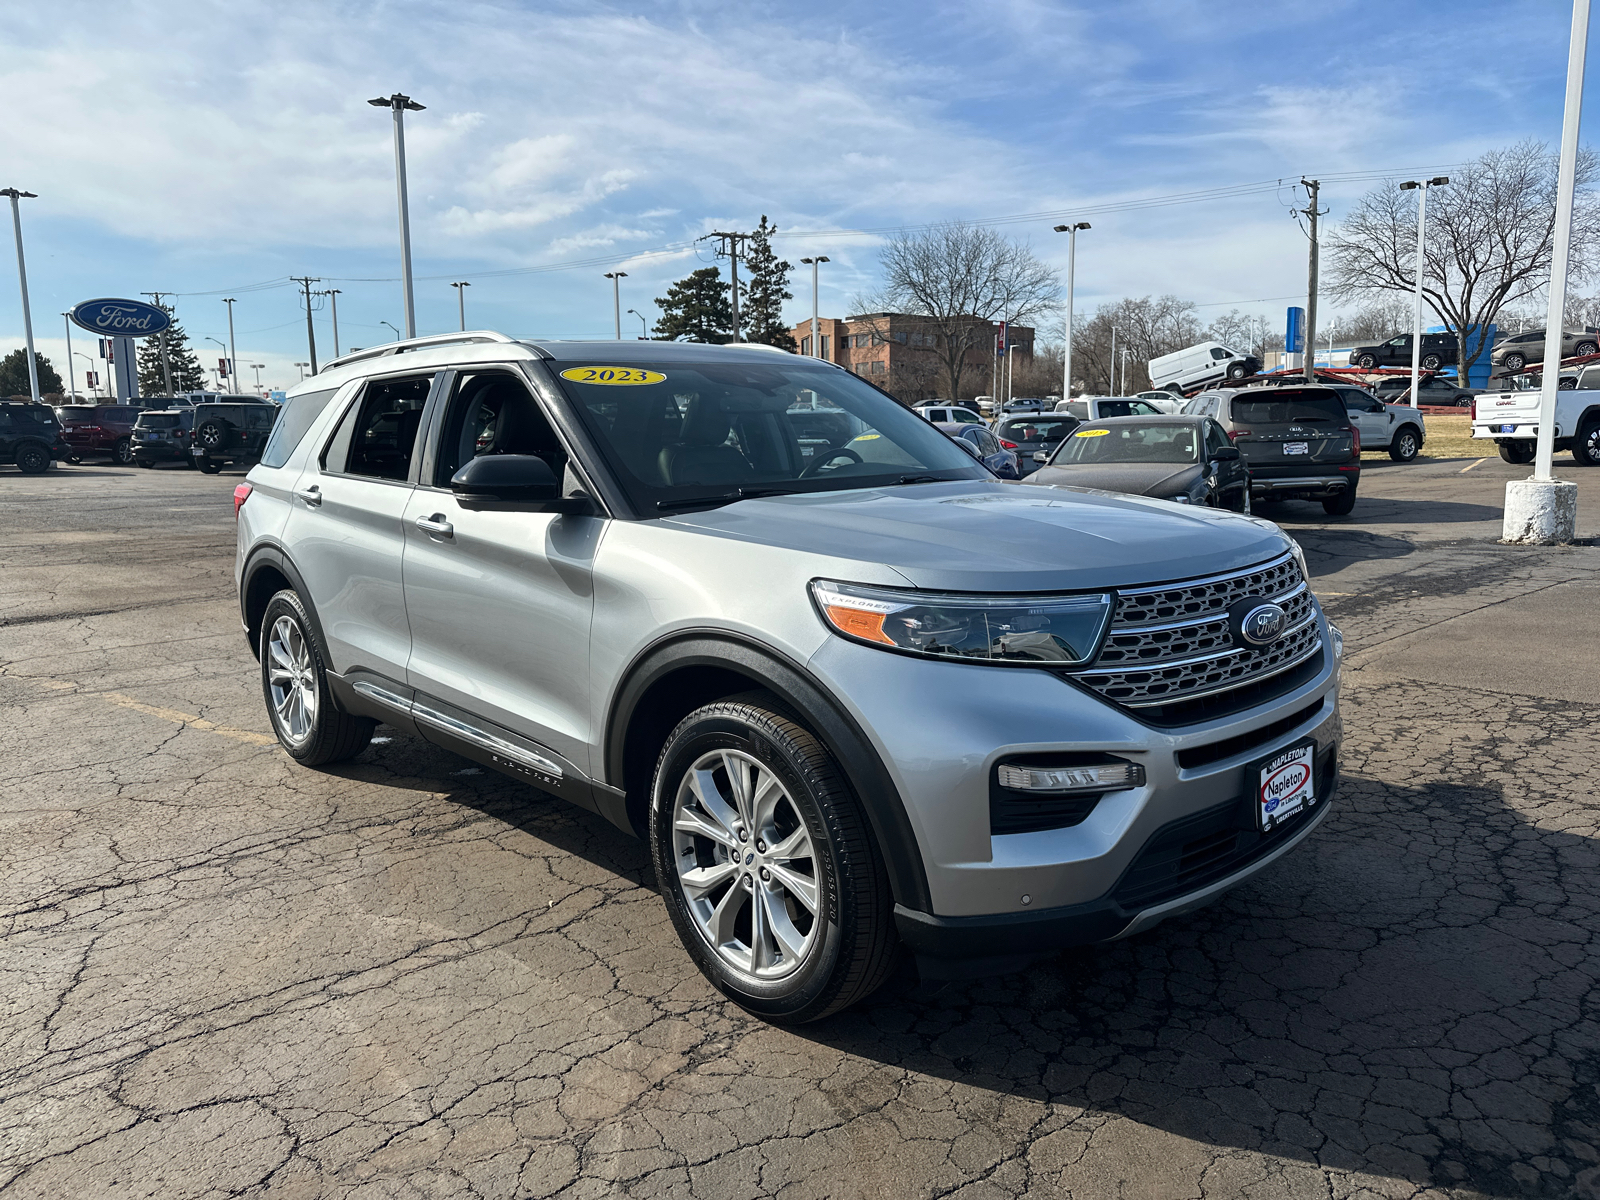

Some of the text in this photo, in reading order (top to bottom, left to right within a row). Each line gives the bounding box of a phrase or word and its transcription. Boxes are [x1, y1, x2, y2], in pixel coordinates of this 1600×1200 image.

[96, 305, 152, 330] Ford
[582, 369, 648, 382] 2023
[831, 596, 891, 611] EXPLORER
[1256, 612, 1280, 637] Ford
[1270, 747, 1305, 772] NAPLETON
[1268, 771, 1303, 798] Napleton
[1276, 804, 1304, 824] LIBERTYVILLE
[822, 850, 836, 891] 255/55
